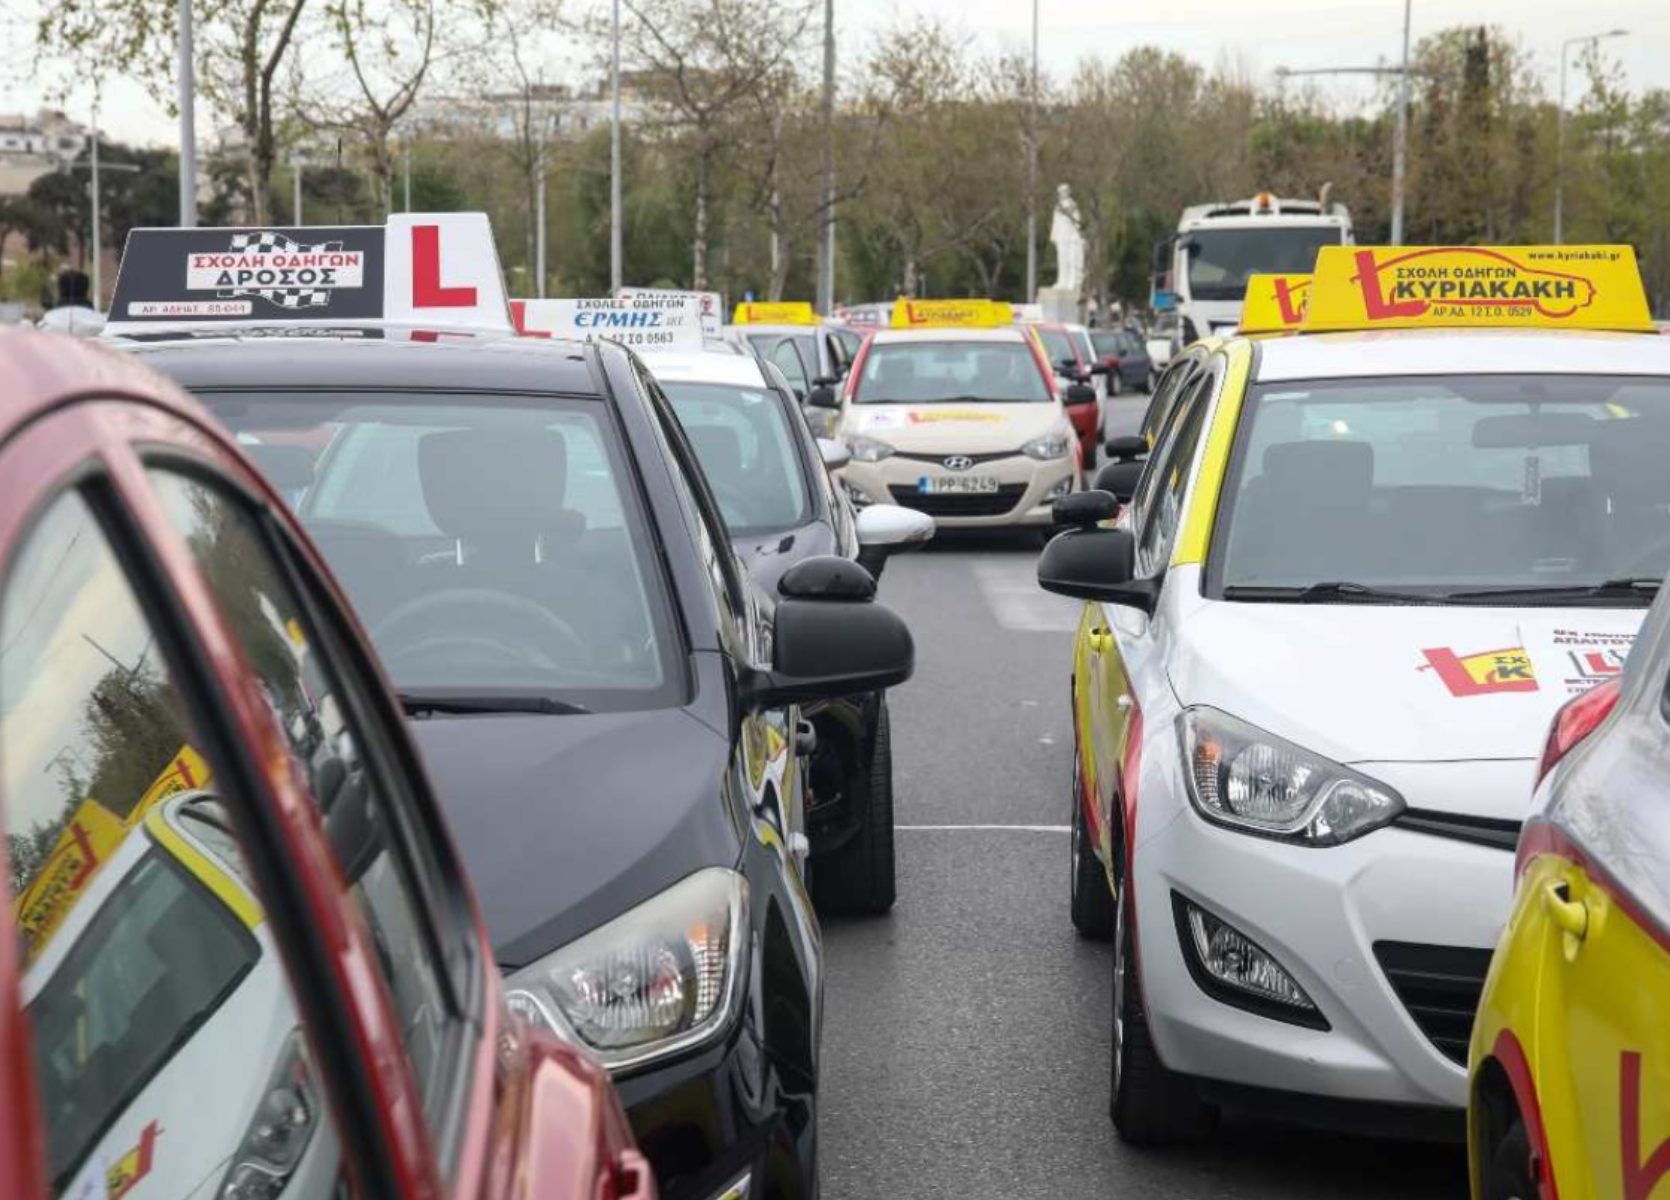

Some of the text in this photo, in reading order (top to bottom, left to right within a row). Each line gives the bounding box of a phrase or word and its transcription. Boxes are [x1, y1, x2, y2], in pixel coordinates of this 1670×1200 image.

[193, 253, 359, 269] ΣΧΟΛΗ ΟΔΗΓΩΝ
[411, 225, 477, 308] L
[216, 269, 338, 286] ΔΡΟΣΟΣ
[1396, 267, 1517, 279] ΣΧΟΛΗ ΟΔΗΓΩΝ
[1396, 280, 1576, 299] ΚΥΡΙΑΚΑΚΗ
[576, 299, 686, 310] ΣΧΟΛΕΣ ΟΔΗΓΩΝ
[574, 311, 662, 328] ΕΡΜΗΣ
